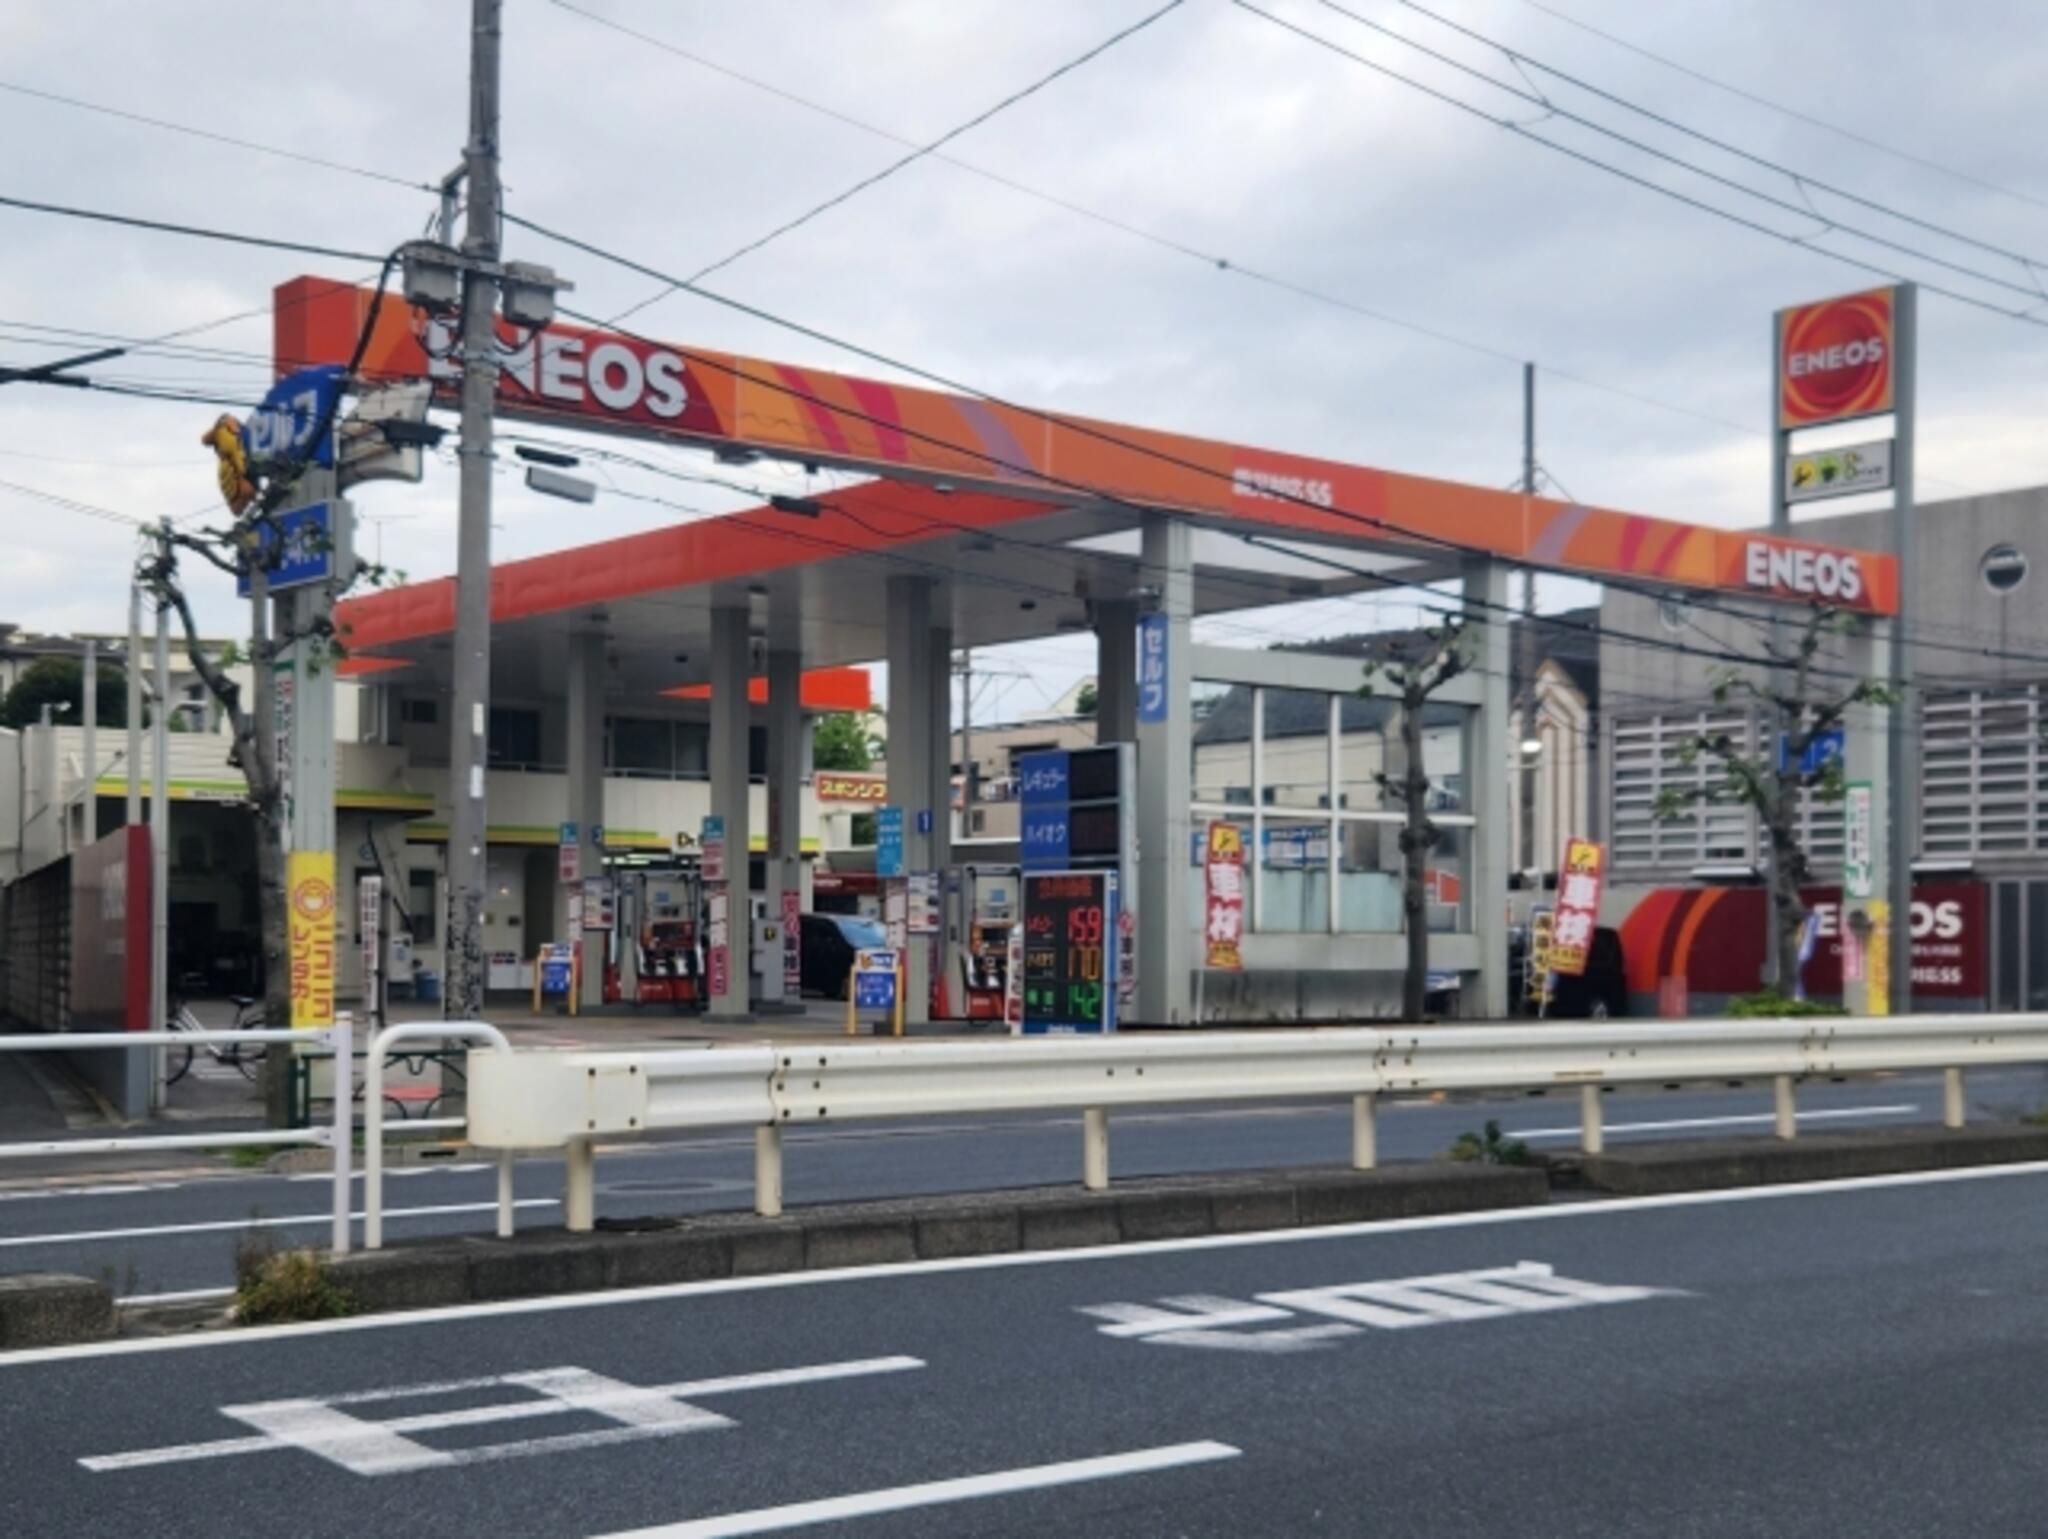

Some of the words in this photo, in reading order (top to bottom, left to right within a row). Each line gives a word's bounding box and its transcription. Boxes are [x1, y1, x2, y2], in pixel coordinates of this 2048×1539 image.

[1788, 337, 1884, 378] ENEOS
[1745, 540, 1862, 601] ENEOS
[1144, 625, 1164, 712] セルフ
[1026, 822, 1067, 844] ハイオク
[1068, 905, 1101, 942] 159
[1068, 945, 1100, 981] 170
[1068, 983, 1100, 1019] 142
